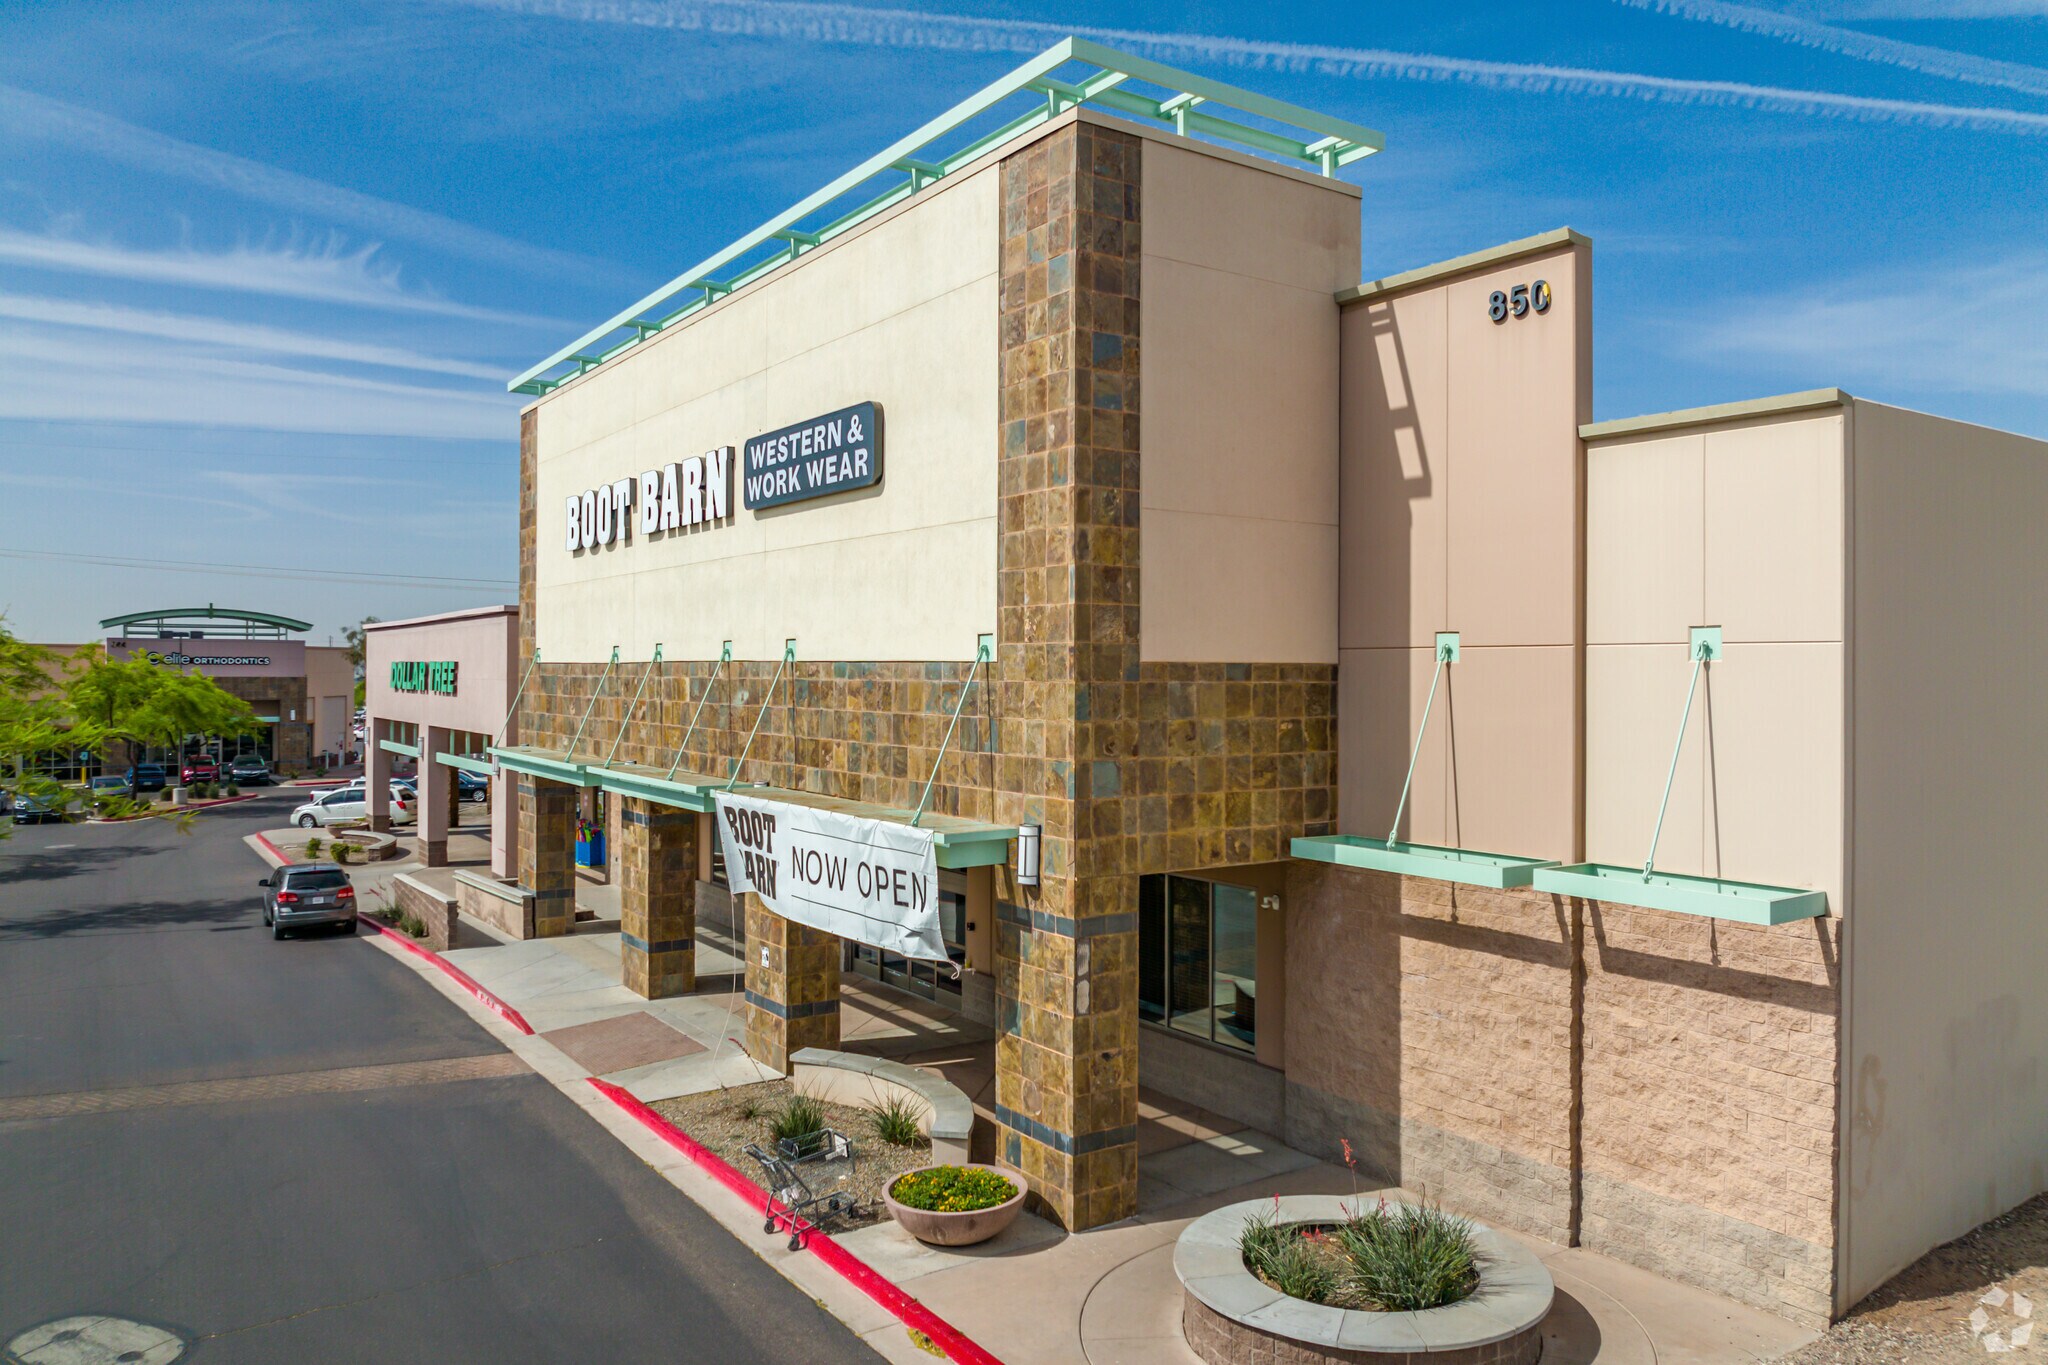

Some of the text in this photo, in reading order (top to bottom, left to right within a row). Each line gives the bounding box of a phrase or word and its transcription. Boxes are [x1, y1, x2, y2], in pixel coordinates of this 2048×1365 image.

[1488, 279, 1552, 321] 850
[750, 414, 864, 471] WESTERN &
[565, 446, 735, 552] BOOT BARN
[747, 449, 869, 502] WORK WEAR
[193, 656, 271, 666] ORTHODONTICS
[390, 661, 457, 694] DOLLAR TREE
[723, 805, 777, 855] BOOT
[738, 848, 777, 901] ARN
[791, 845, 928, 913] NOW OPEN
